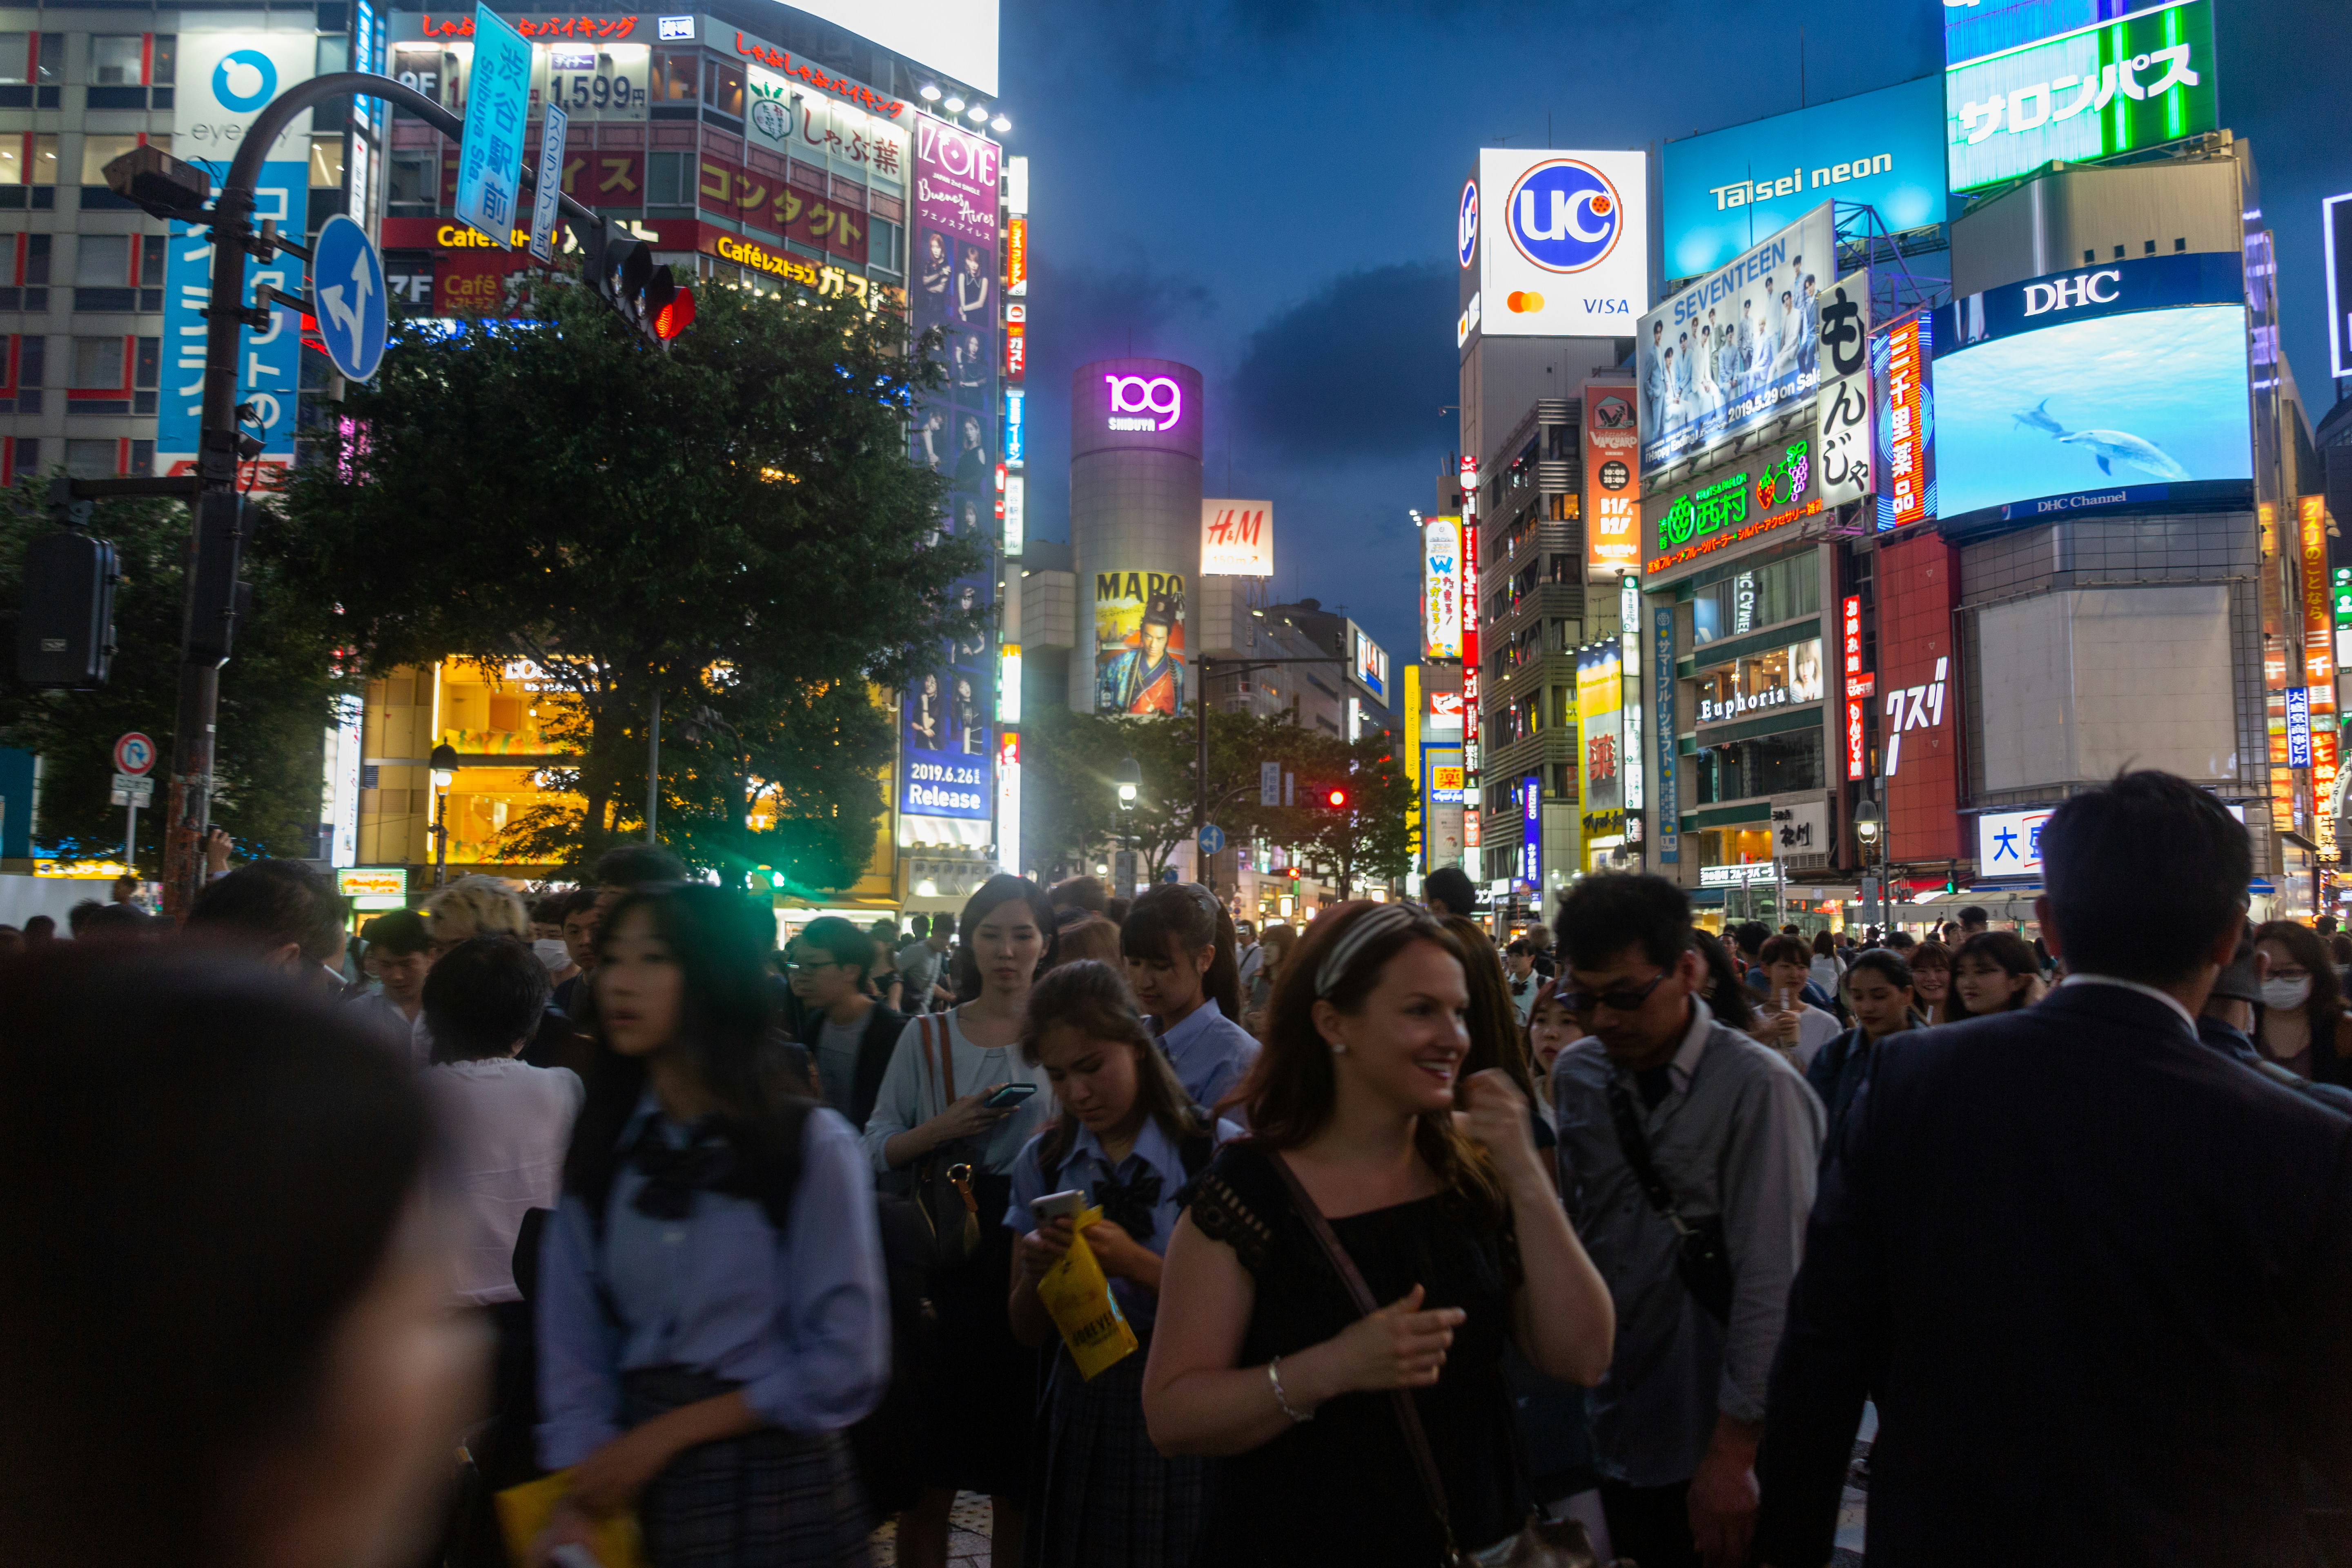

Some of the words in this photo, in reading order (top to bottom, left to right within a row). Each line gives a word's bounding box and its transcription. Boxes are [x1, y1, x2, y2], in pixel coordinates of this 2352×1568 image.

[423, 15, 638, 38] しゃぶぶバイキング
[736, 31, 905, 118] しゃぶしゃぶバイキング
[470, 56, 494, 138] Shibuya
[1959, 43, 2199, 145] サロンパス
[482, 42, 525, 226] 渋谷駅前
[803, 107, 899, 175] しゃぶ葉
[918, 178, 964, 207] Buenos
[1709, 167, 1802, 212] Taisei
[1811, 153, 1892, 189] neon
[700, 163, 862, 246] コンタクト
[958, 200, 995, 227] Aires
[388, 275, 434, 303] 7F
[443, 274, 497, 295] Café
[1674, 237, 1786, 327] SEVENTEEN
[2023, 270, 2121, 318] DHC
[1583, 299, 1630, 314] VISA
[1009, 337, 1023, 374] ガスト
[1105, 374, 1181, 432] 109
[1728, 388, 1779, 423] 2019.5.29
[1779, 381, 1796, 403] on
[1821, 286, 1868, 492] もんじゃ
[1107, 416, 1156, 432] SHIBUYA
[1590, 431, 1637, 449] VANGUARD
[1889, 331, 1915, 514] 三千里薬品
[1600, 498, 1629, 514] B1F
[1696, 485, 1748, 535] 西村
[2036, 499, 2066, 513] DHC
[2069, 490, 2127, 508] Channel
[1207, 509, 1264, 547] H&M
[1600, 517, 1631, 535] B2F
[2302, 501, 2324, 620] クスリのことなら
[1096, 572, 1183, 603] MARO
[2302, 632, 2333, 704] 三千里
[1657, 638, 1673, 768] サマーフルーツギフト
[1700, 686, 1786, 722] Euphoria
[2290, 691, 2308, 765] 大盛堂商事ビル
[911, 762, 973, 784] 2019.6.26
[1588, 733, 1617, 781] 薬
[909, 783, 981, 810] Release
[1439, 768, 1461, 788] 薬
[1528, 784, 1537, 820] MIZUHO
[1527, 843, 1536, 881] みずほ銀行
